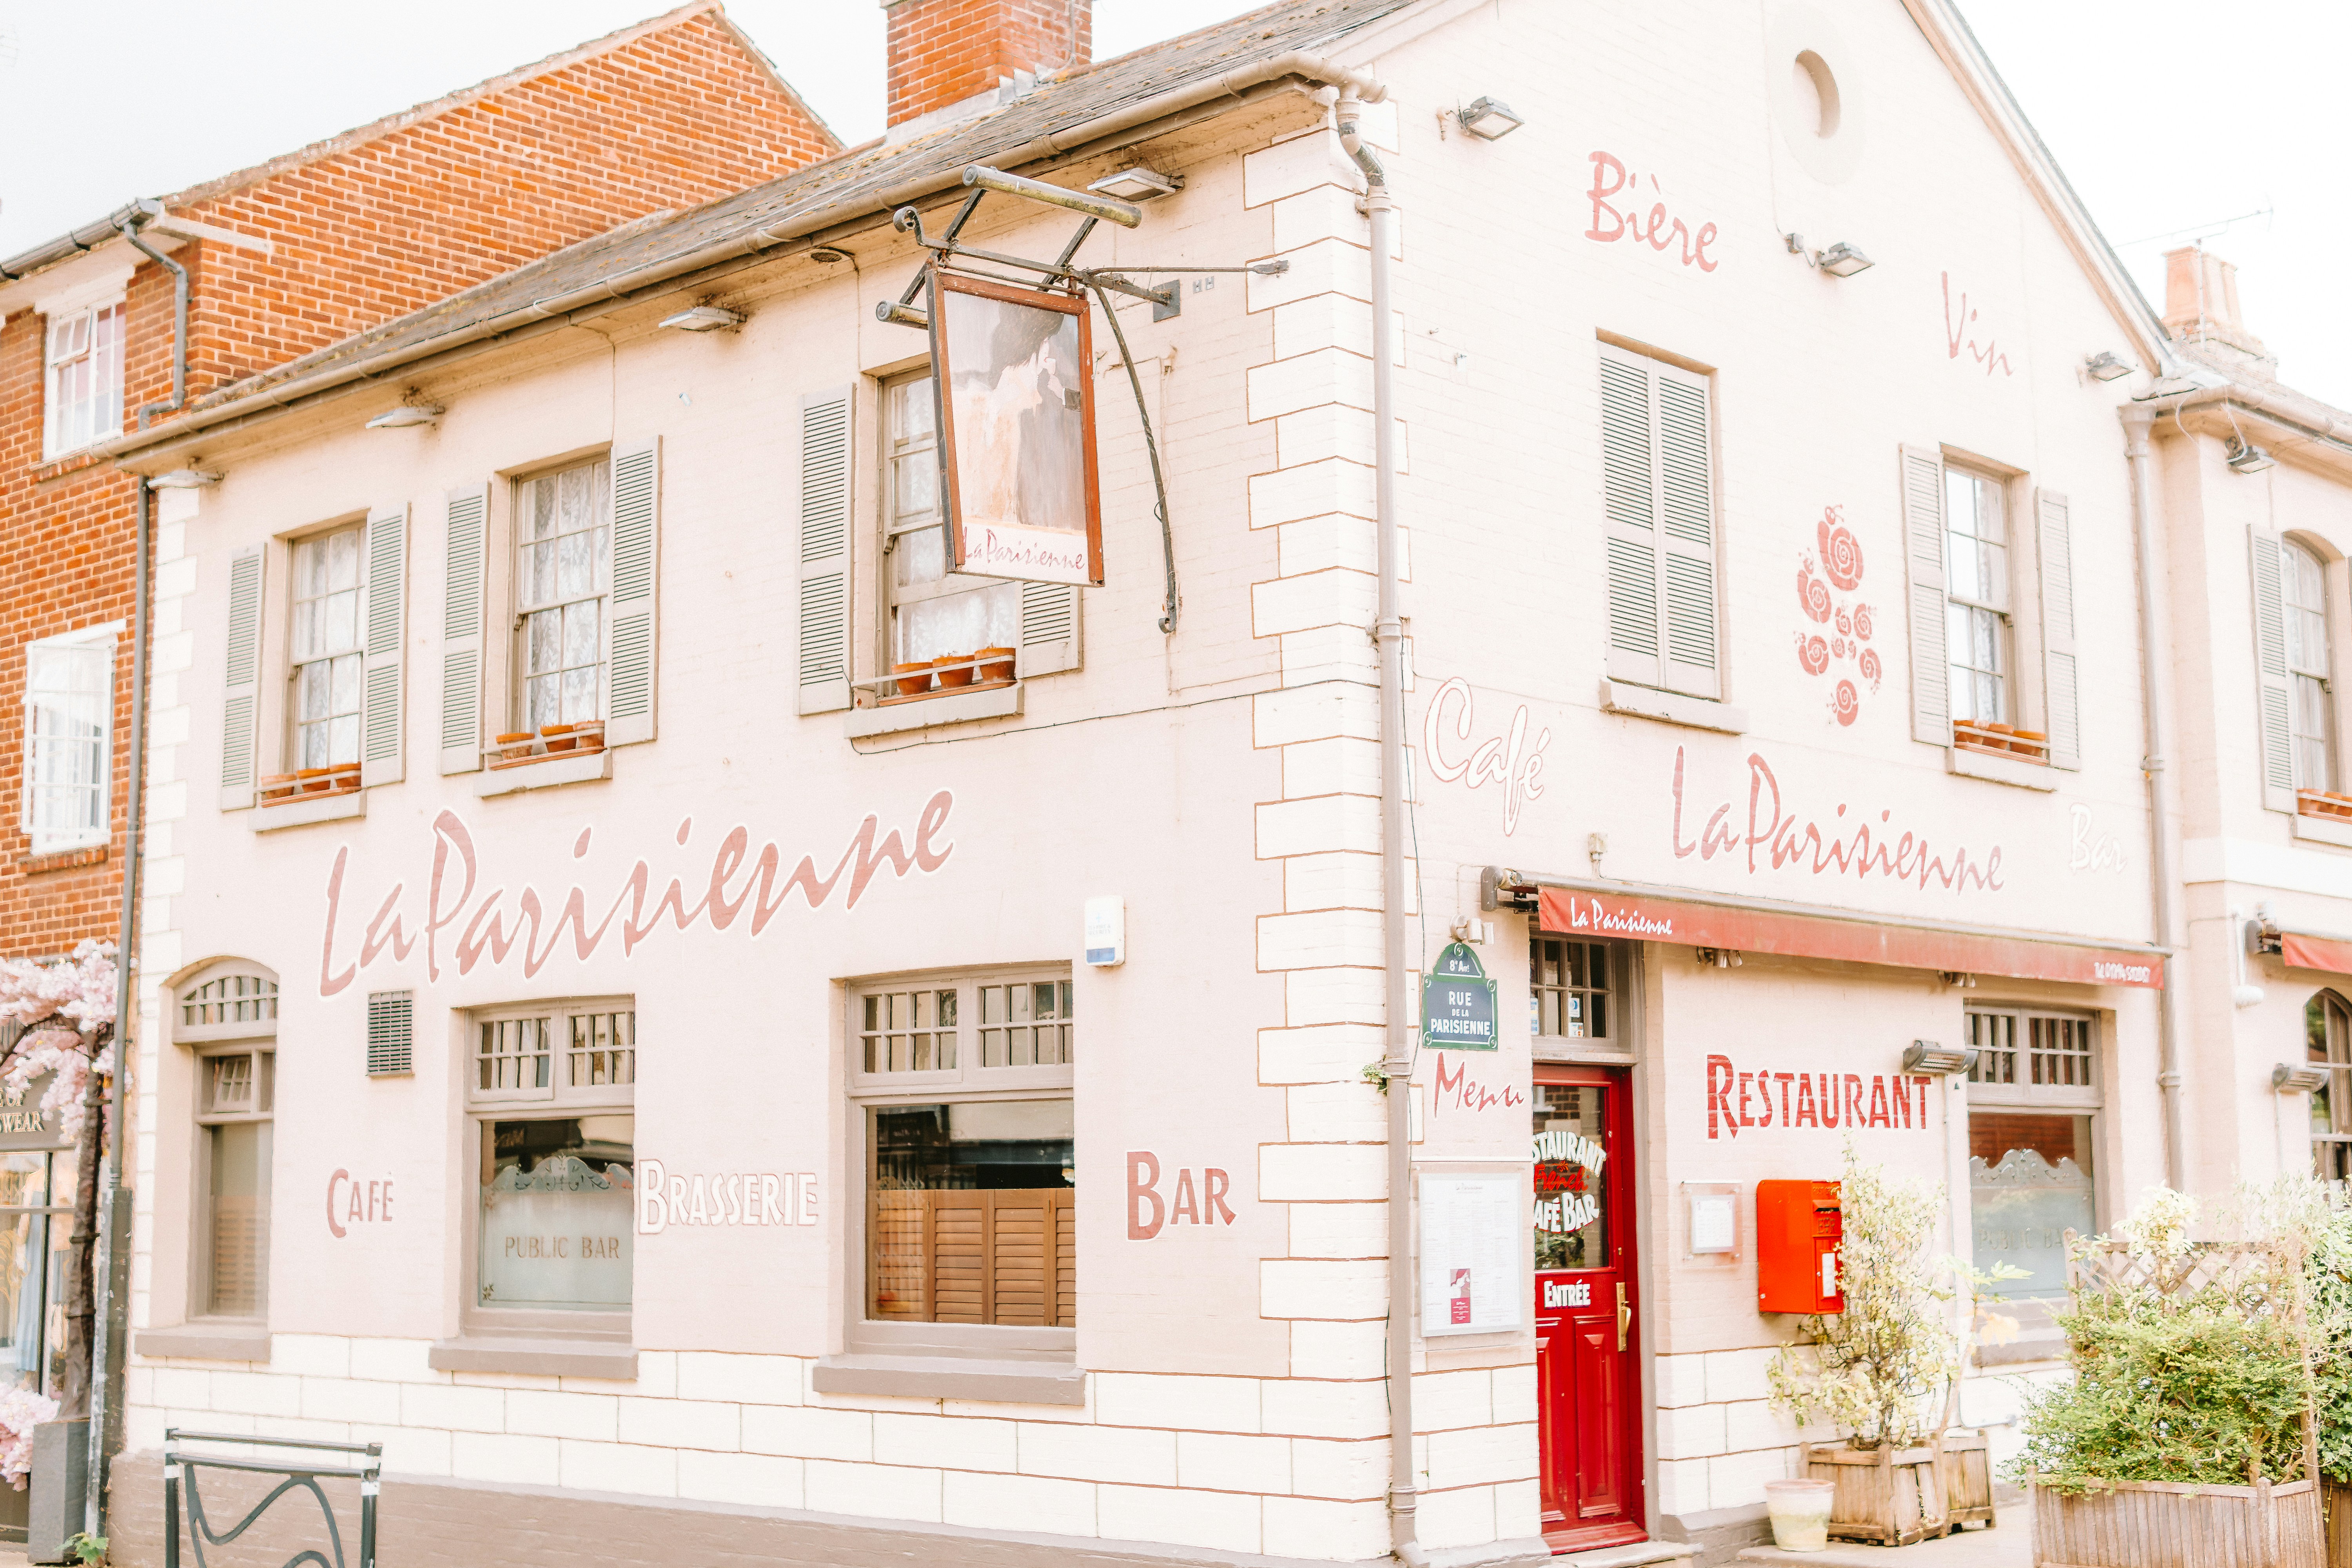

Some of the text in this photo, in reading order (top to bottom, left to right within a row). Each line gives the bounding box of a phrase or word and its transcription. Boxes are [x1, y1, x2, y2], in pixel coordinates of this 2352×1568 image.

[1584, 151, 1719, 273] Bière
[1941, 272, 2015, 377] Vin
[963, 525, 1085, 570] La Parisienne
[1425, 677, 1552, 837] Café
[1671, 744, 2004, 895] La Parisienne
[2069, 803, 2127, 874] Bar
[319, 789, 955, 998] La Parisienne
[1571, 897, 1673, 935] La Parisienne
[1430, 1018, 1491, 1036] PARISIENNE
[1448, 991, 1472, 1006] RUE
[1461, 1009, 1470, 1017] LA
[1434, 1051, 1524, 1118] Menu
[1707, 1054, 1932, 1140] RESTAURANT
[0, 1111, 44, 1132] WEAR
[326, 1168, 395, 1238] CAFÉ
[638, 1159, 819, 1235] BRASSERIE
[1126, 1151, 1237, 1241] BAR
[1561, 1192, 1601, 1232] BAR
[505, 1236, 620, 1259] PUBLIC BAR
[1978, 1229, 2034, 1251] PUBLIC
[1544, 1278, 1591, 1308] ENTRÉE
